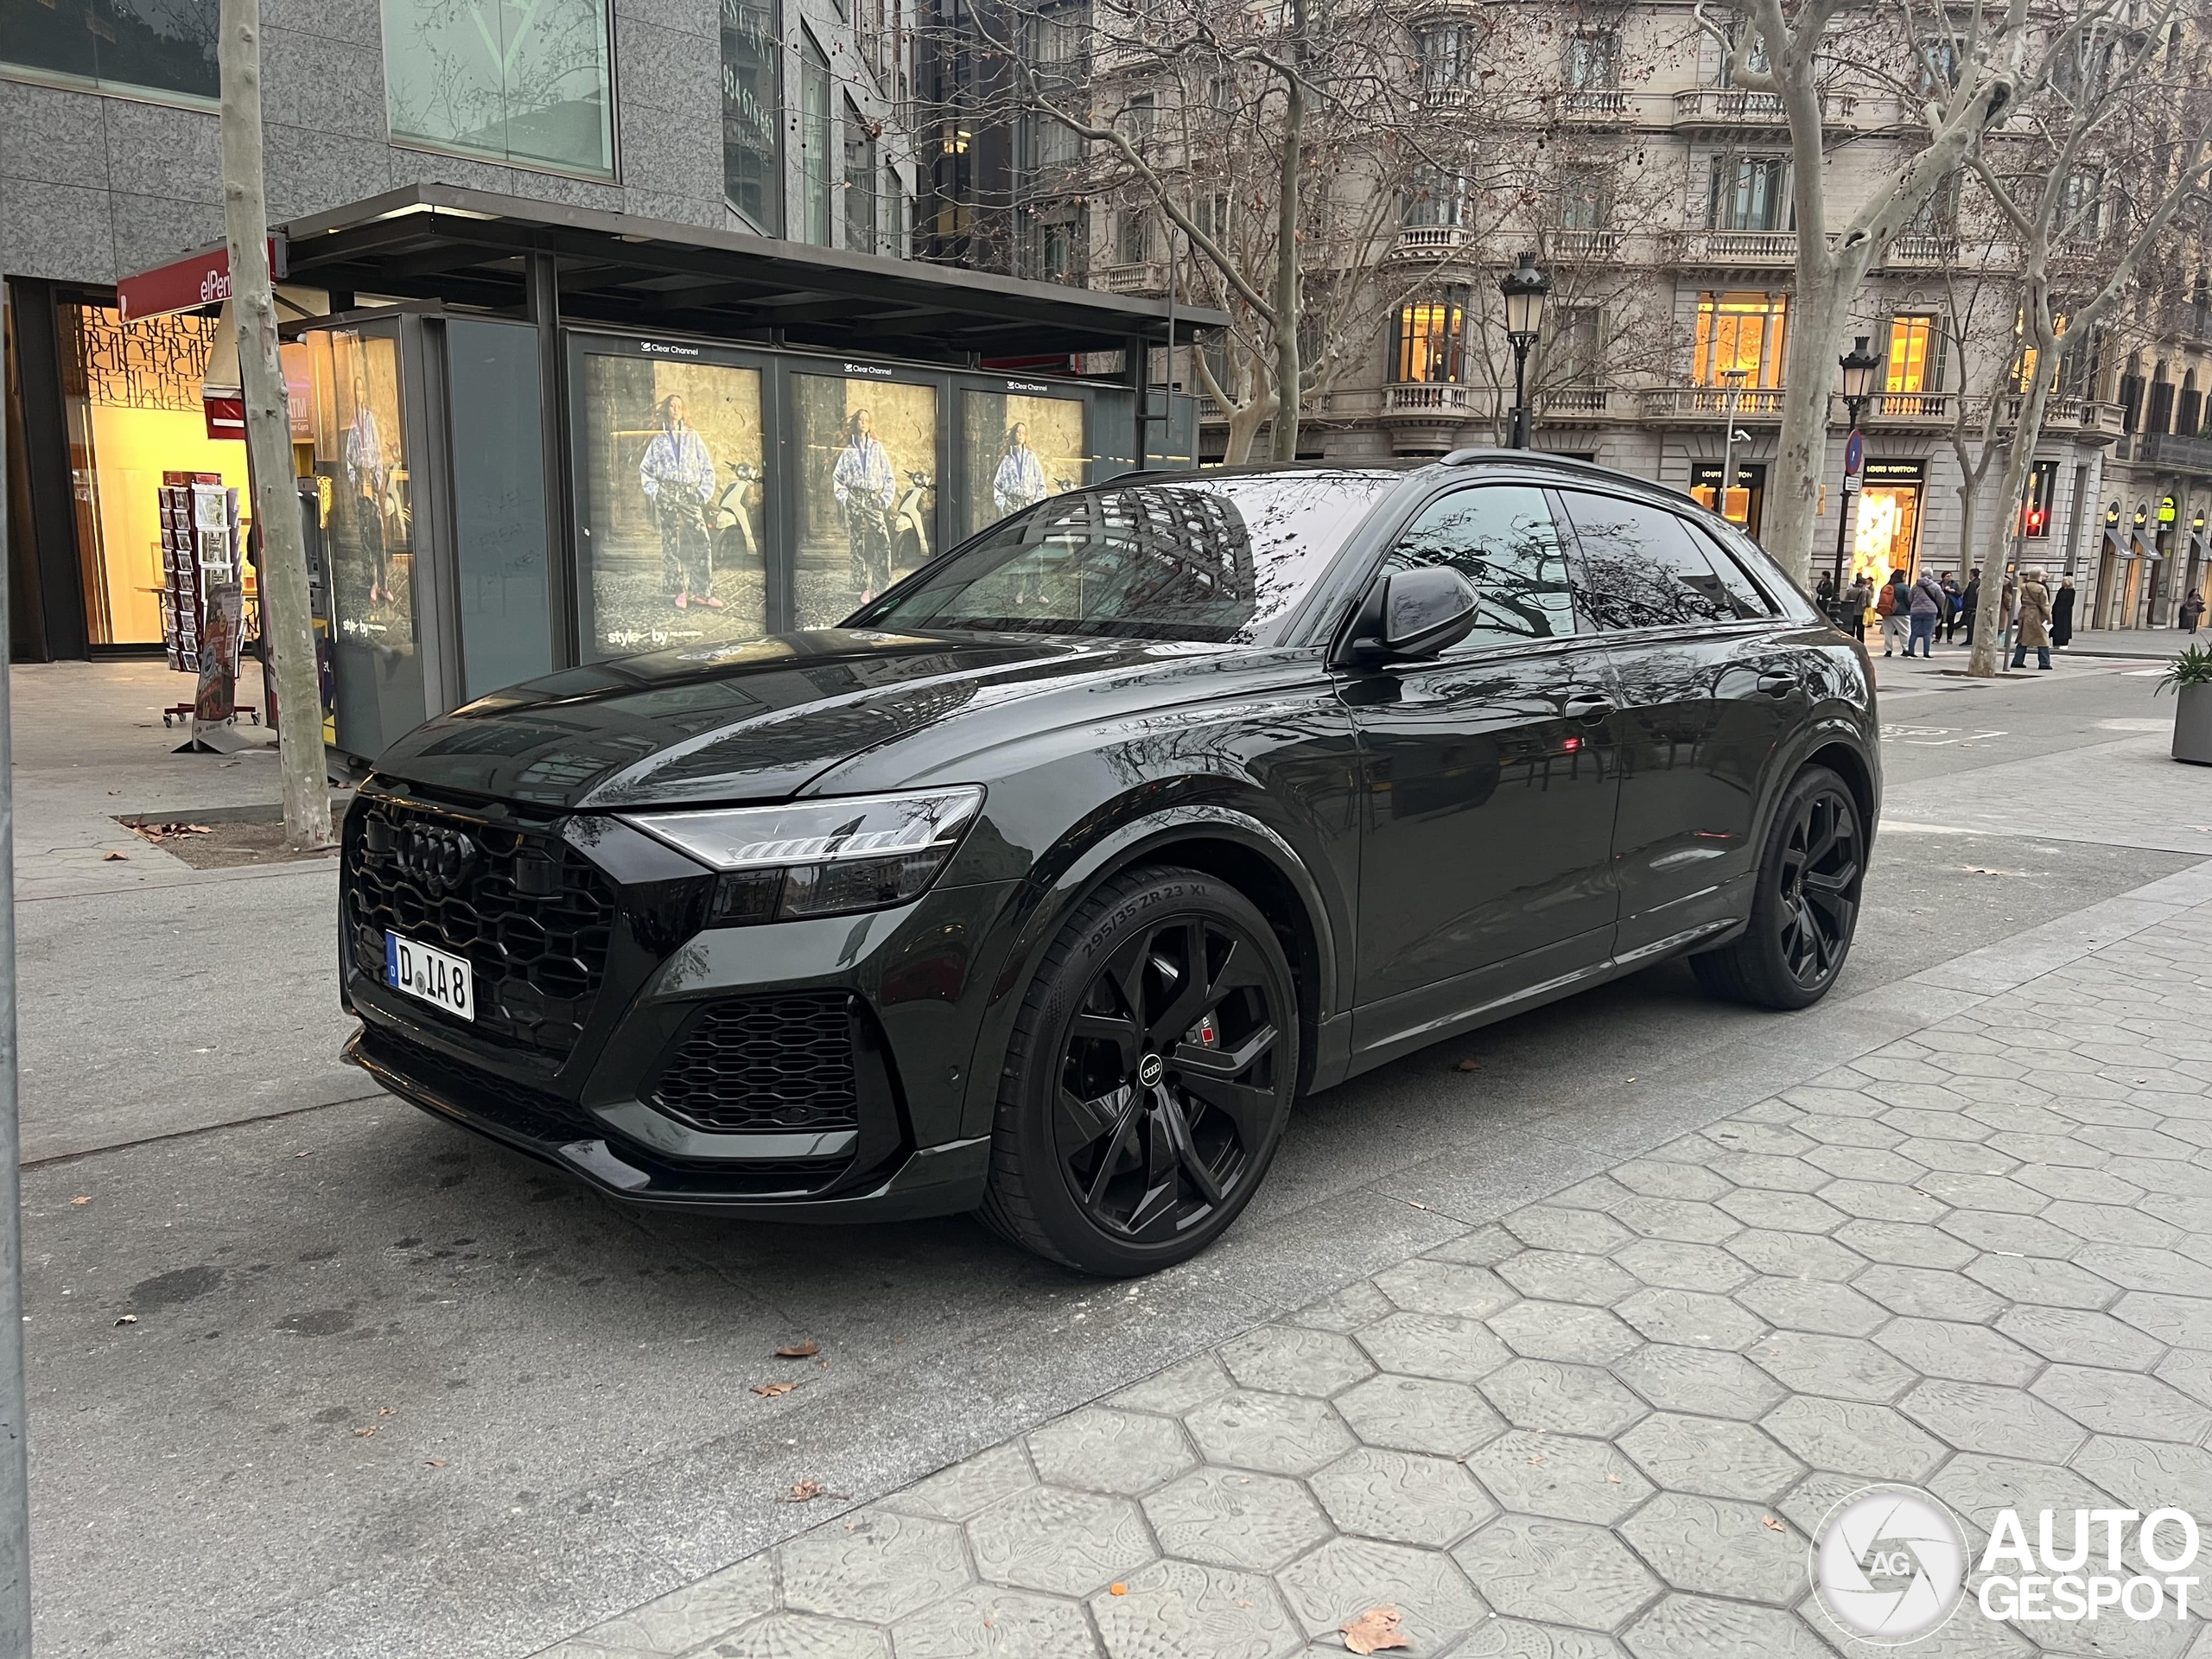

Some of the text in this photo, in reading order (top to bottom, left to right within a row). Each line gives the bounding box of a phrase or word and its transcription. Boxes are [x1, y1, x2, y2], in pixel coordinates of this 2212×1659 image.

[723, 64, 741, 107] 934
[200, 266, 232, 302] elPeri
[651, 344, 699, 356] Clear Channel
[853, 365, 892, 376] Clear Channel
[1701, 470, 1722, 479] LOUIS
[1866, 465, 1918, 474] LOUIS VUITTON
[607, 628, 640, 647] style
[652, 628, 669, 645] by
[1082, 904, 1137, 959] 295/35
[1139, 891, 1162, 909] ZR
[1163, 885, 1185, 899] 23
[398, 944, 413, 987] D
